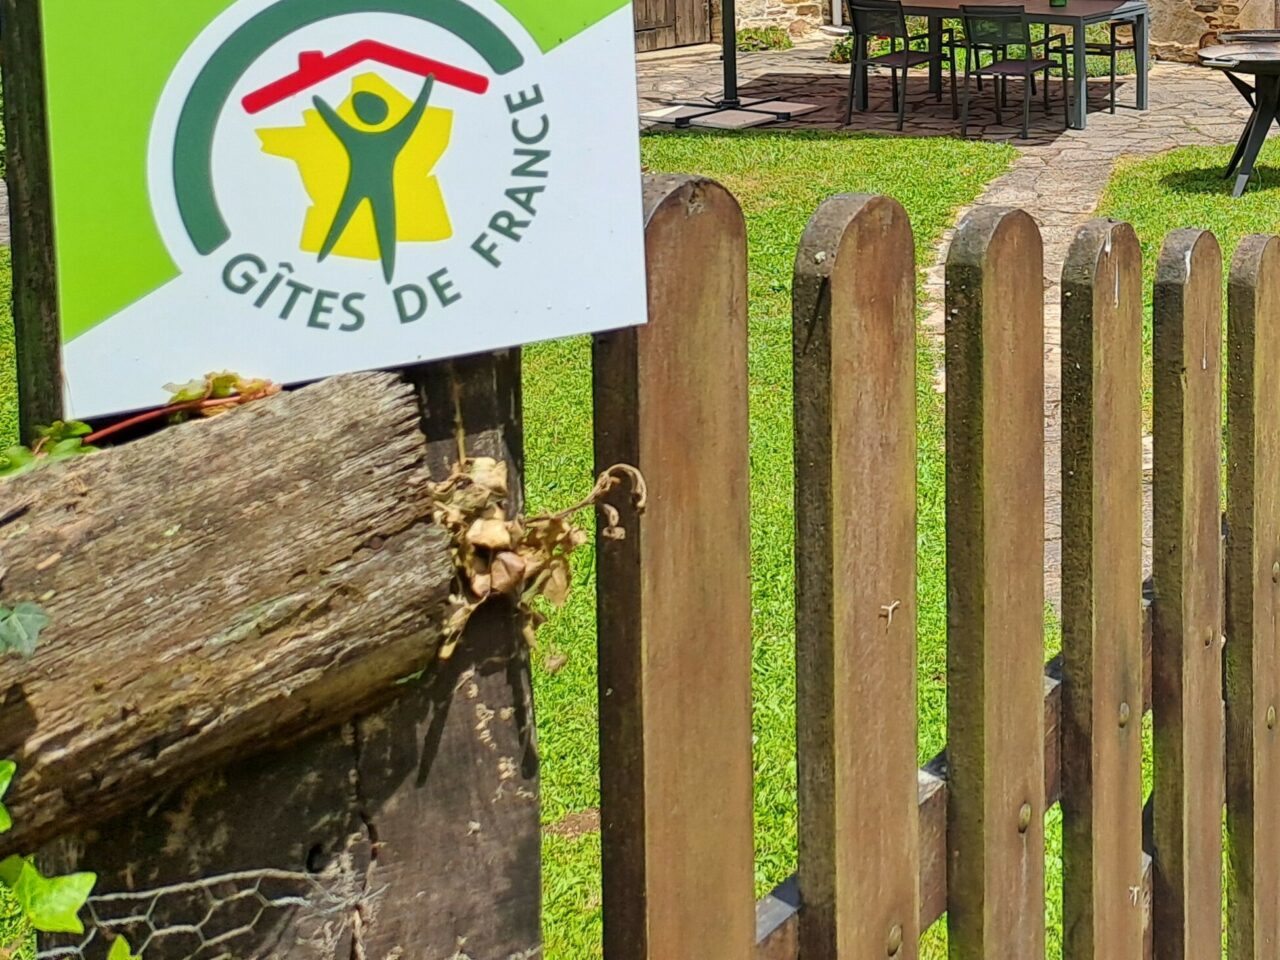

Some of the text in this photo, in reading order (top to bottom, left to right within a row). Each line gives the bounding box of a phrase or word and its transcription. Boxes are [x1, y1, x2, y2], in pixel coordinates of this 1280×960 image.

[221, 84, 551, 332] GÎTES DE FRANCE
